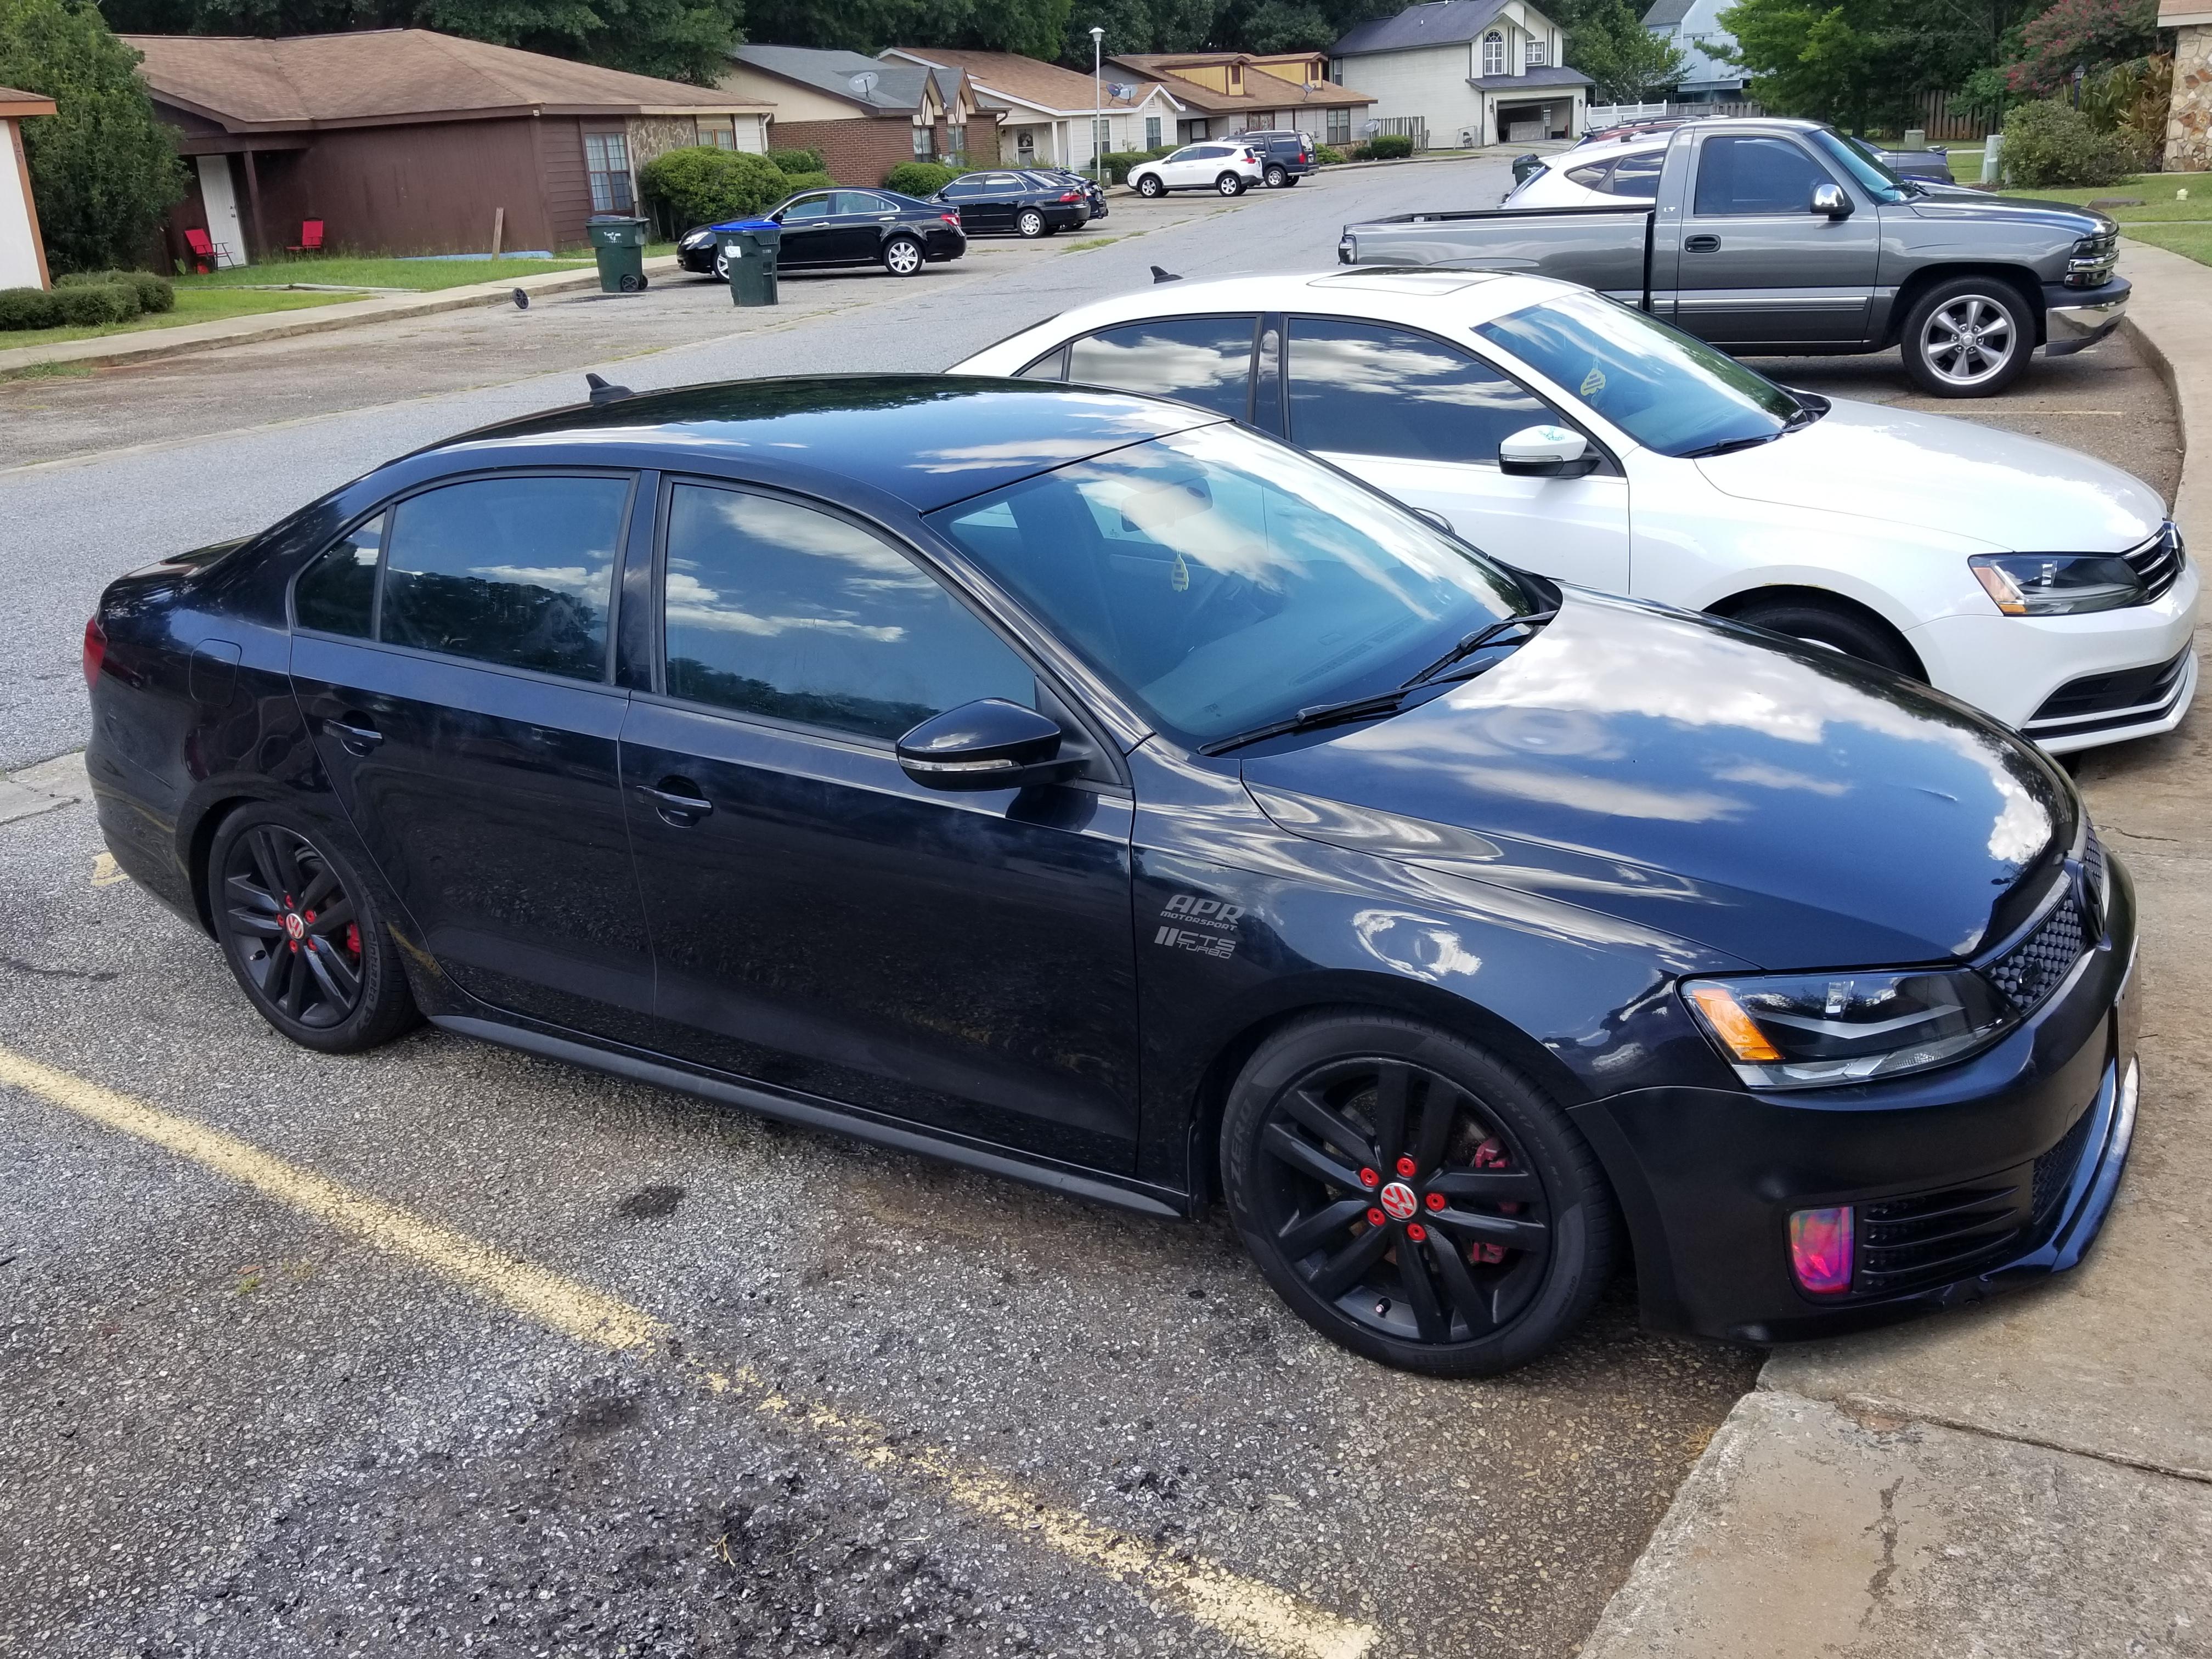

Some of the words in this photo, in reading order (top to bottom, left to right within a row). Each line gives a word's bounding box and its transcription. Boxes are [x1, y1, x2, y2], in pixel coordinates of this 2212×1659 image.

[1165, 894, 1246, 924] APR
[1160, 911, 1238, 931] MOTORSPORT
[1176, 941, 1232, 959] TURBO
[1177, 930, 1236, 952] CTS
[1231, 1097, 1251, 1187] ZERO
